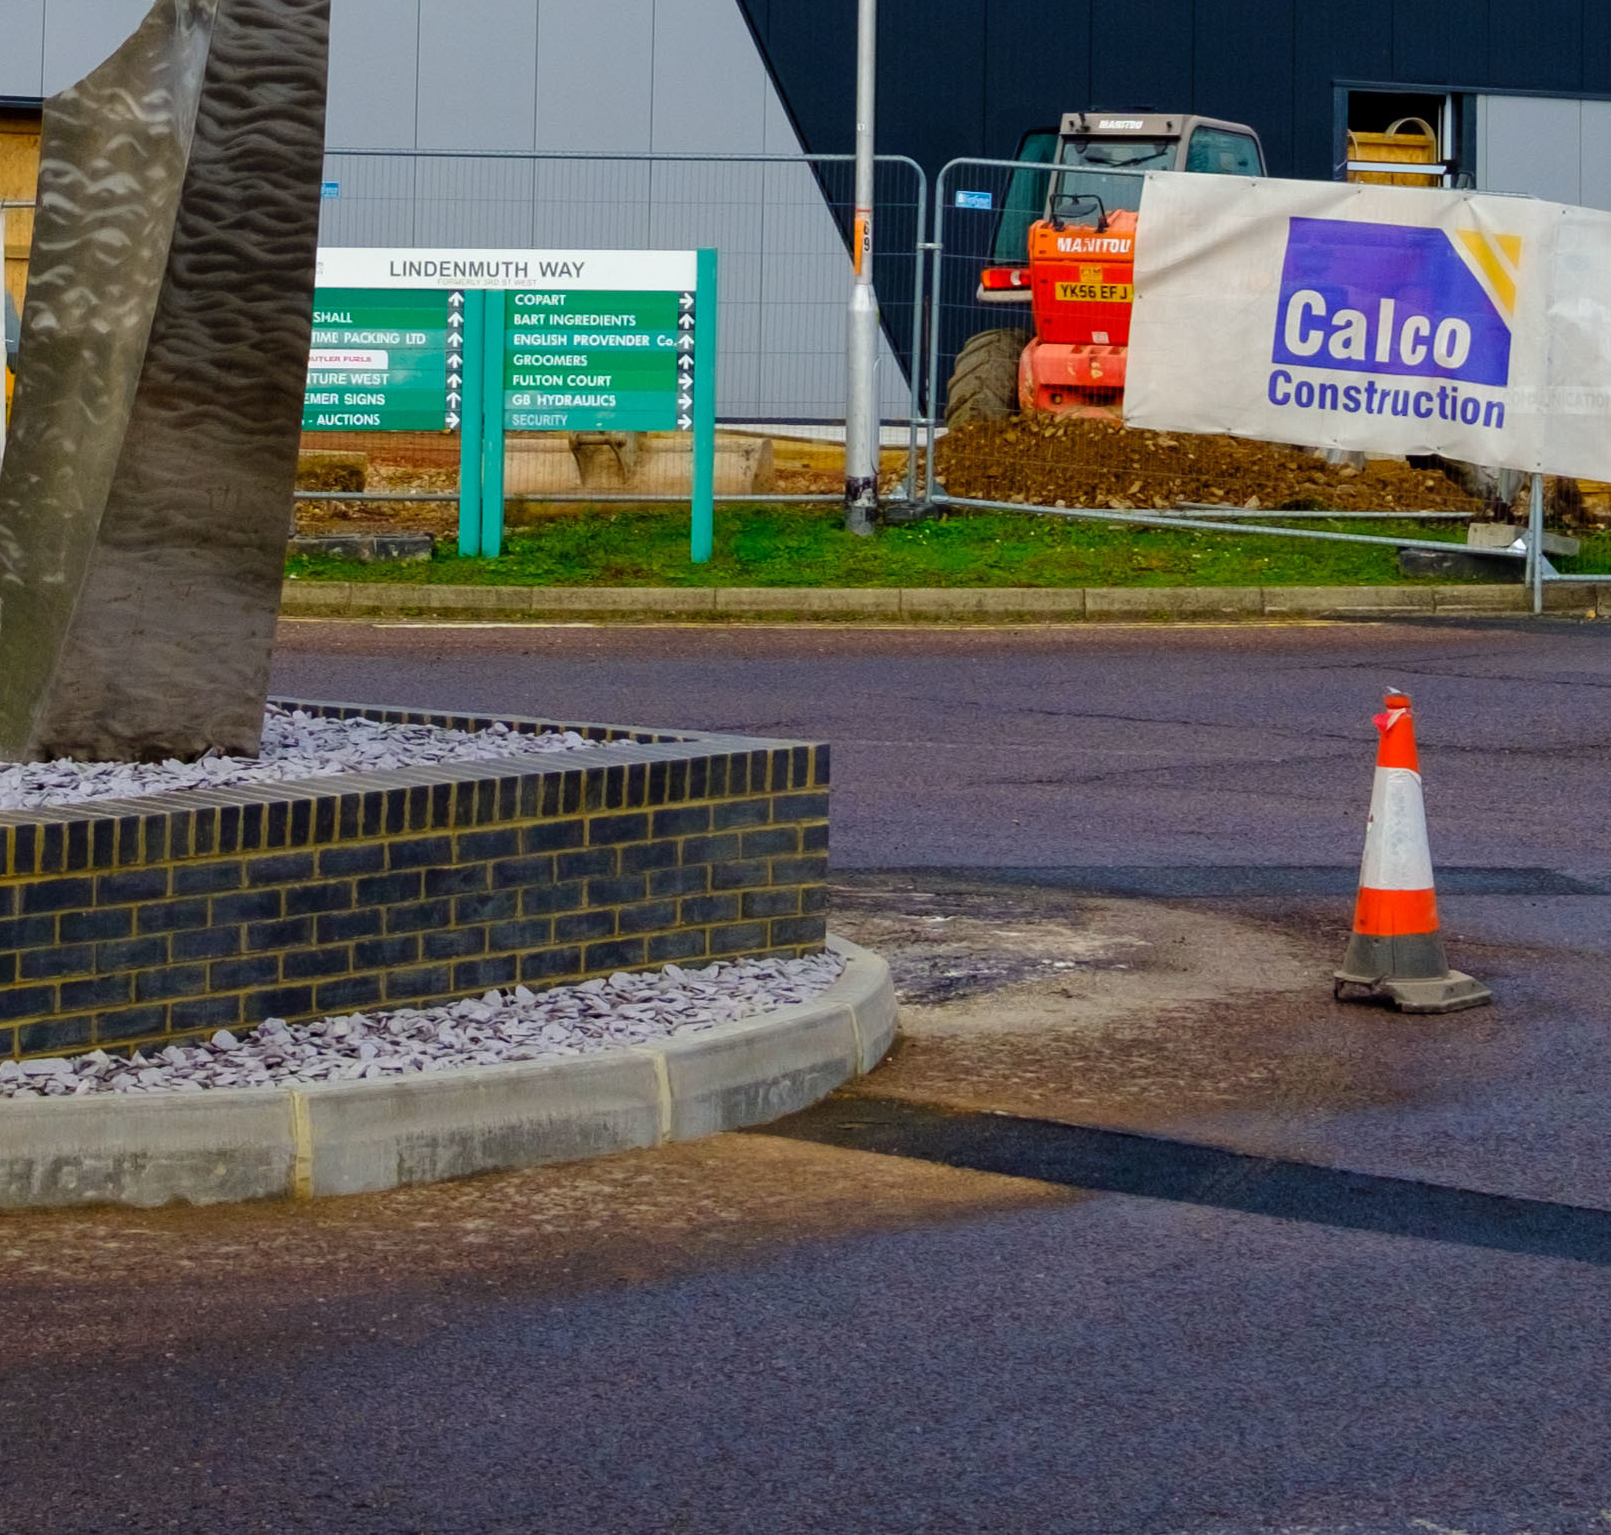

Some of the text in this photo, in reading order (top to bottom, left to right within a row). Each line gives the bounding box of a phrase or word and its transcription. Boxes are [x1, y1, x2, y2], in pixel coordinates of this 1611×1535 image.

[1099, 120, 1143, 129] MANITOU
[1057, 237, 1132, 253] MANITOU
[390, 261, 585, 278] LINDENMUTH WAY
[1060, 285, 1097, 299] YK56
[514, 294, 566, 306] COPART
[514, 314, 637, 327] BART INGREDIENTS
[1283, 289, 1472, 369] Calco
[344, 332, 400, 345] PACKING
[406, 333, 426, 345] LTD
[513, 334, 677, 347] ENGLISH PROVENDER Co.
[513, 354, 588, 367] GROOMERS
[350, 373, 390, 385] WEST
[512, 375, 612, 387] FULTON COURT
[344, 393, 385, 405] SIGNS
[512, 393, 616, 406] GB HYDRAULICS
[1267, 369, 1506, 429] Construction
[316, 414, 380, 426] AUCTIONS
[512, 414, 568, 426] SECURITY
